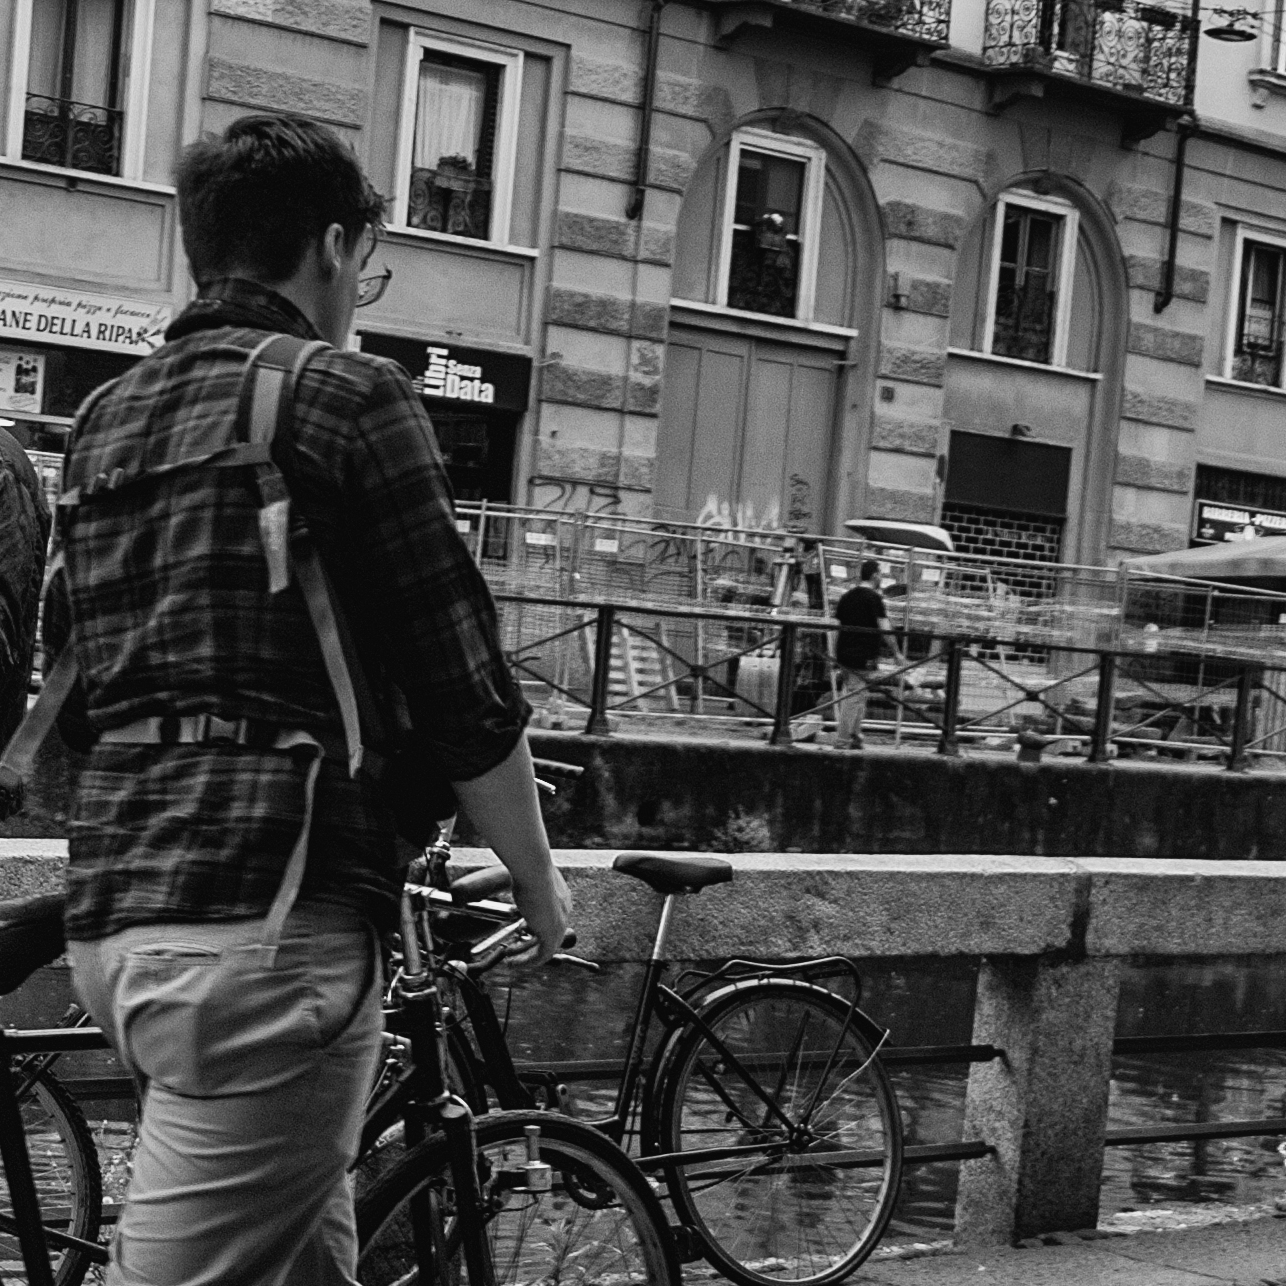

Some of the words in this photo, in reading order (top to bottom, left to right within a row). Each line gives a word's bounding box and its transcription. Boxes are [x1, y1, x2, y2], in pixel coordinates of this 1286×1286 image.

[36, 314, 92, 340] DELLA
[95, 322, 137, 346] RIPA
[444, 373, 495, 403] Data
